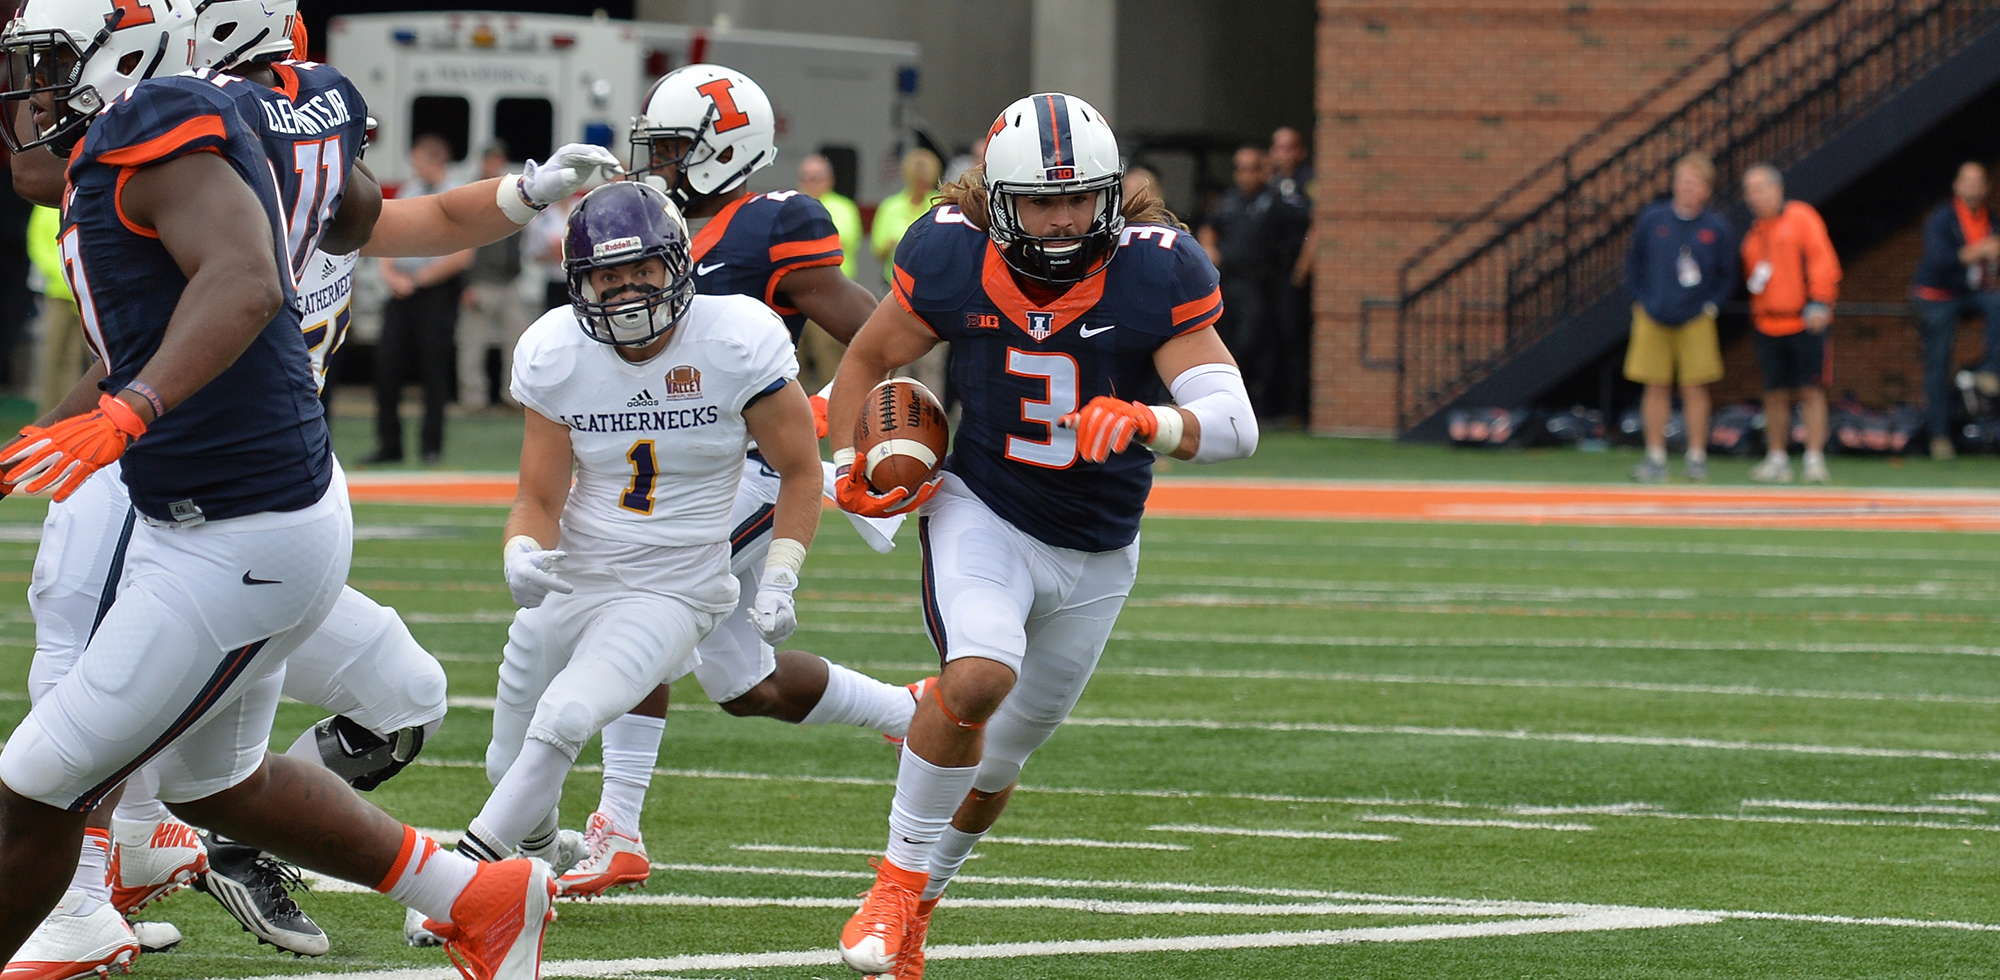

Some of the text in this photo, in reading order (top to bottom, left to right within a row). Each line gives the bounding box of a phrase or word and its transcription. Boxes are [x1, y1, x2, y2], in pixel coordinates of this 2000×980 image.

[696, 78, 750, 135] I
[604, 240, 632, 252] Riddell
[627, 399, 659, 408] adidas
[665, 376, 702, 395] VALLEY
[1005, 346, 1081, 471] 3
[618, 439, 660, 516] 1
